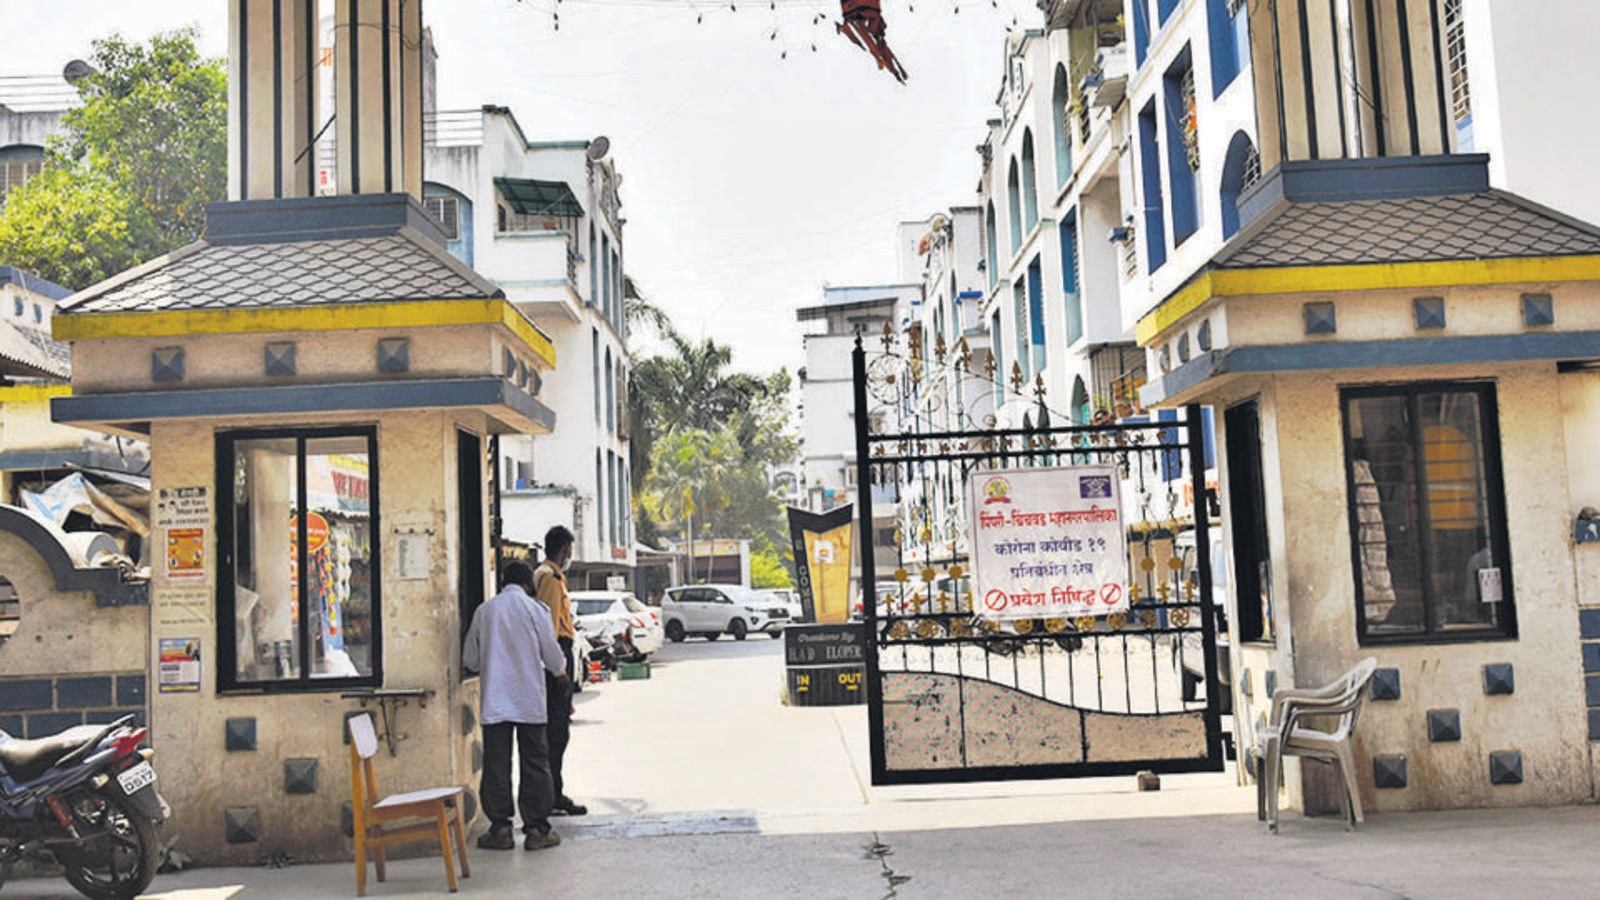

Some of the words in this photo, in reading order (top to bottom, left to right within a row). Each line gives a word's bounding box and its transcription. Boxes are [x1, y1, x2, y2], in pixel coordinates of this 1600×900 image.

[994, 538, 1036, 556] कोरोना
[1010, 588, 1046, 607] प्रवेश
[1051, 585, 1095, 606] निषिद्ध
[796, 674, 811, 686] IN
[838, 672, 863, 684] OUT
